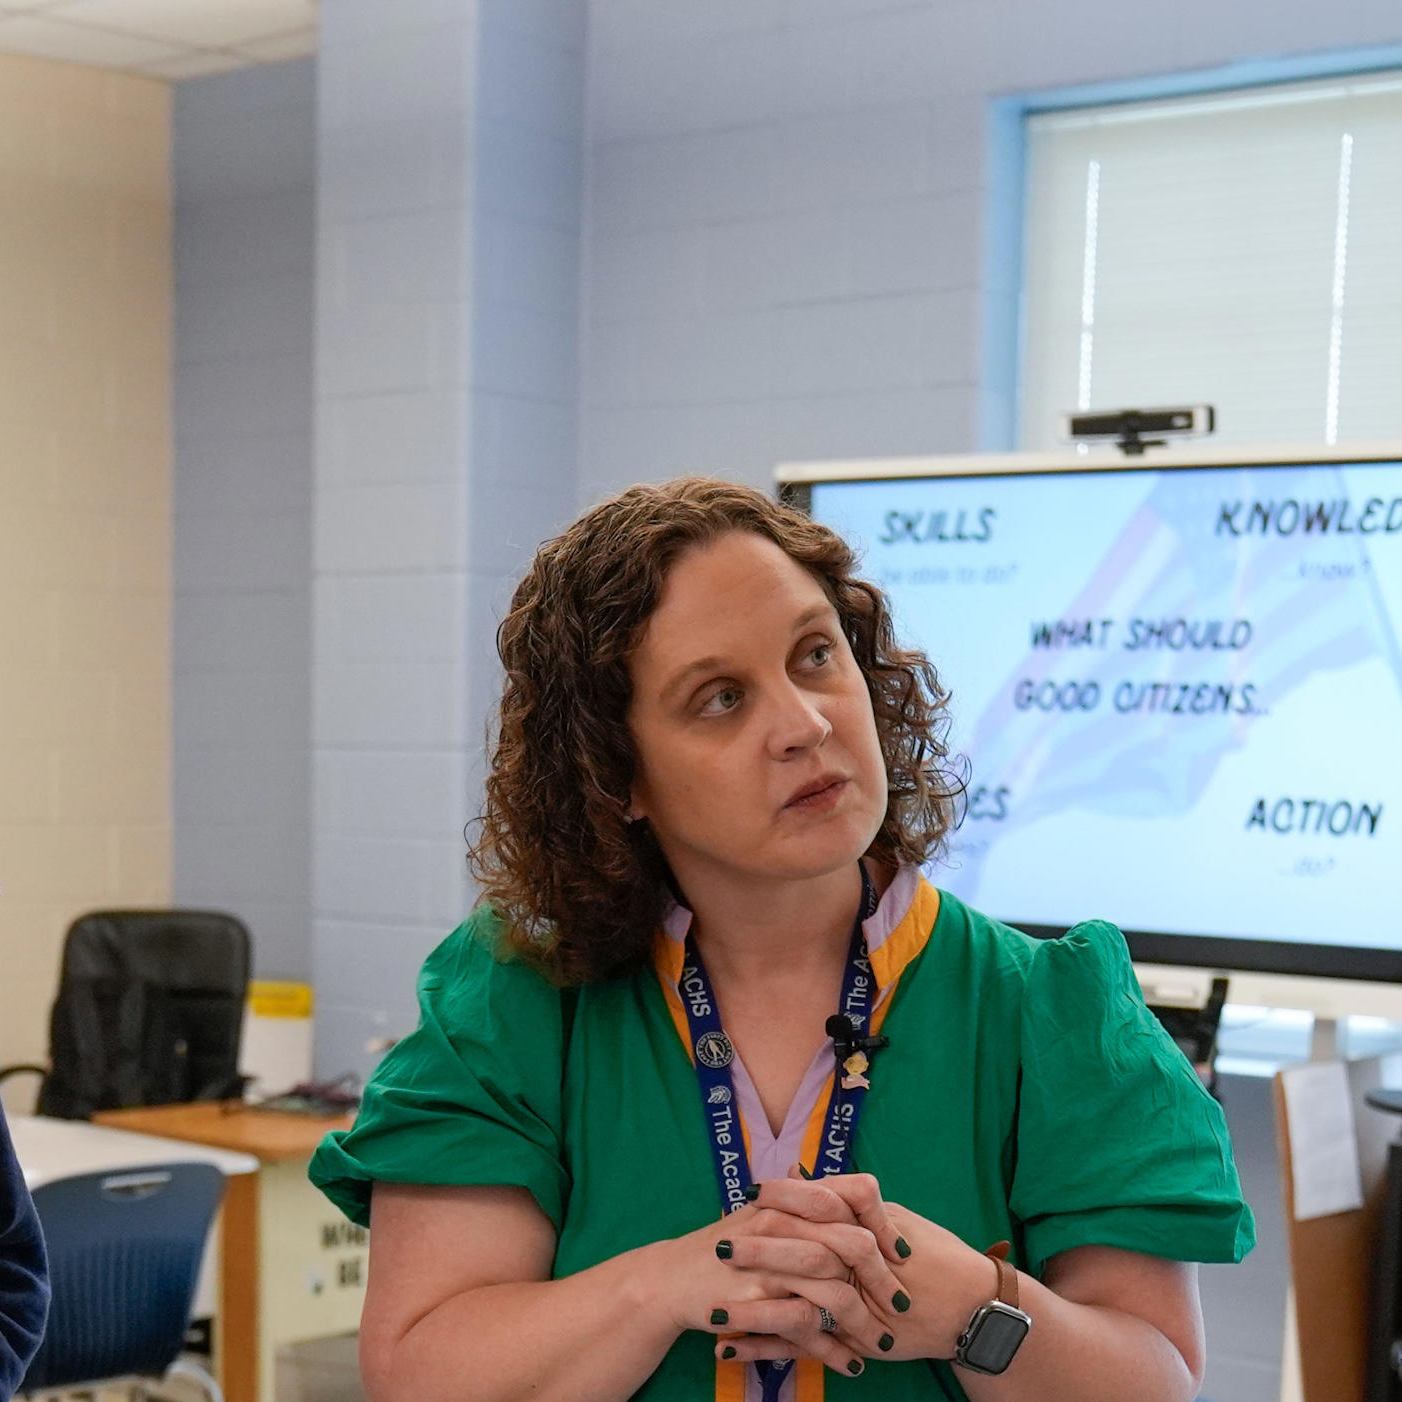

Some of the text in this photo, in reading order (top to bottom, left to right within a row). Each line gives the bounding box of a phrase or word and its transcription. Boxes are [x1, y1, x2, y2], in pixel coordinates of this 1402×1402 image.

[879, 507, 995, 544] SKILLS
[1030, 618, 1254, 651] WHAT SHOULD
[1013, 679, 1101, 713] GOOD
[1244, 797, 1384, 837] ACTION
[682, 964, 712, 1019] ACHS
[847, 974, 870, 1012] The
[712, 1104, 746, 1214] The Acade
